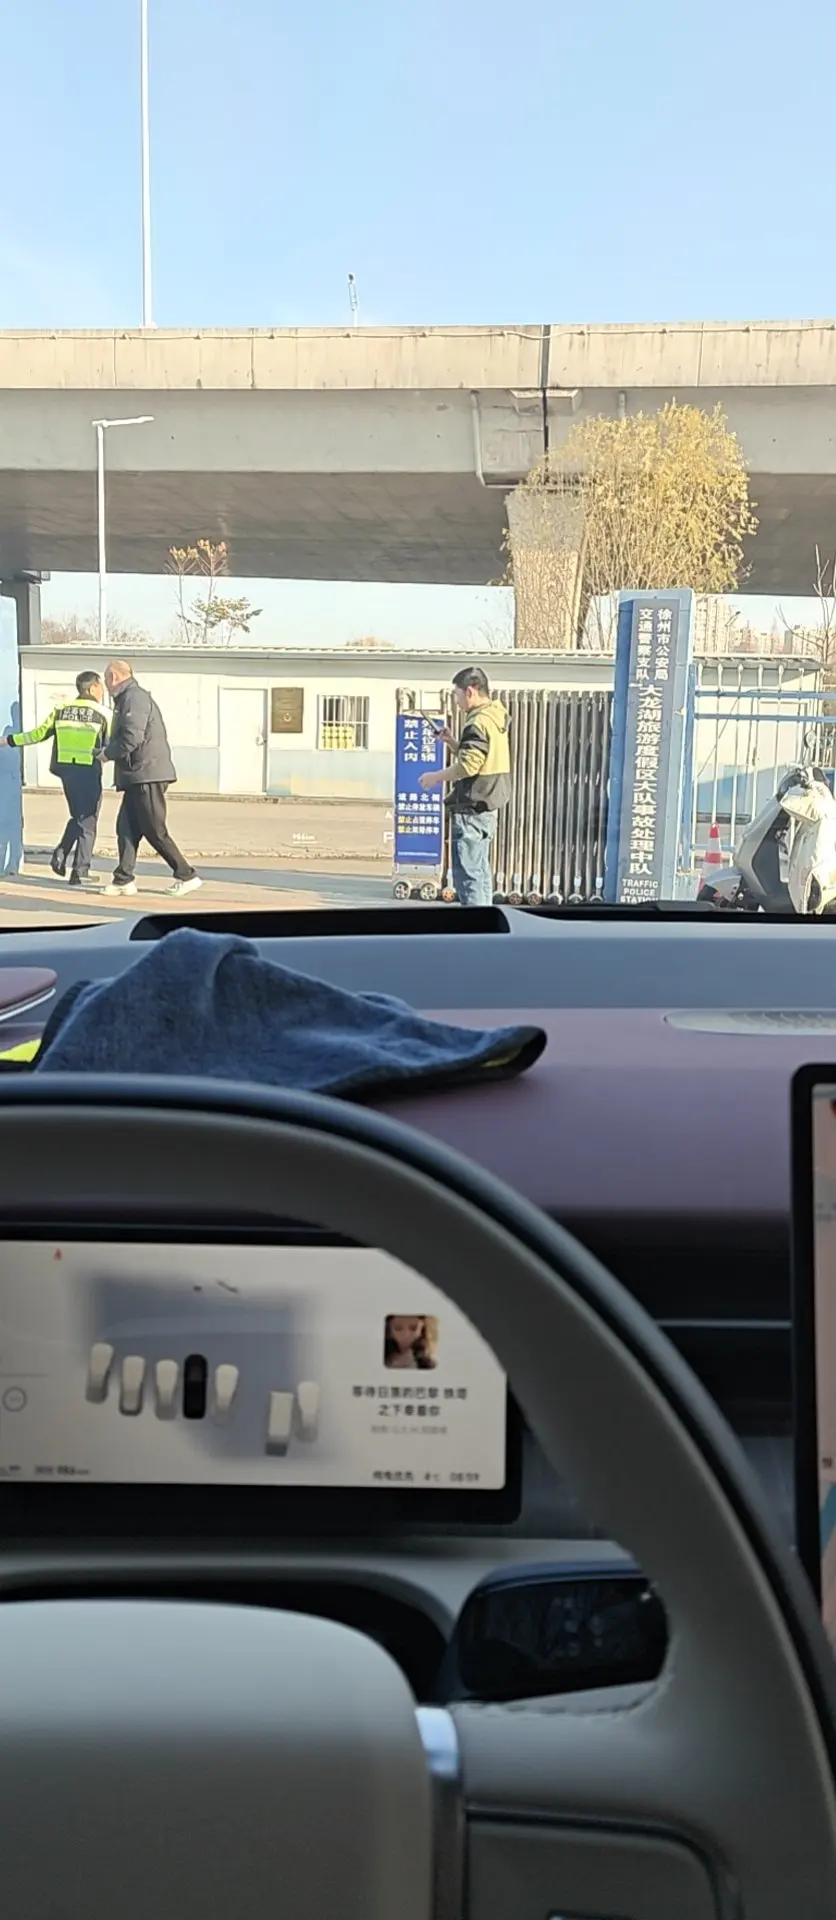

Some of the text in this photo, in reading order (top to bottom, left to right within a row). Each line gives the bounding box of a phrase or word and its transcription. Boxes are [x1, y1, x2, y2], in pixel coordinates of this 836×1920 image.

[636, 608, 654, 680] 交通警察支队
[655, 608, 673, 680] 徐州市公安局
[629, 684, 663, 874] 大龙湖旅游度假区大队事故处理中队
[622, 879, 659, 888] TRAFFIC
[624, 888, 655, 896] POLICE
